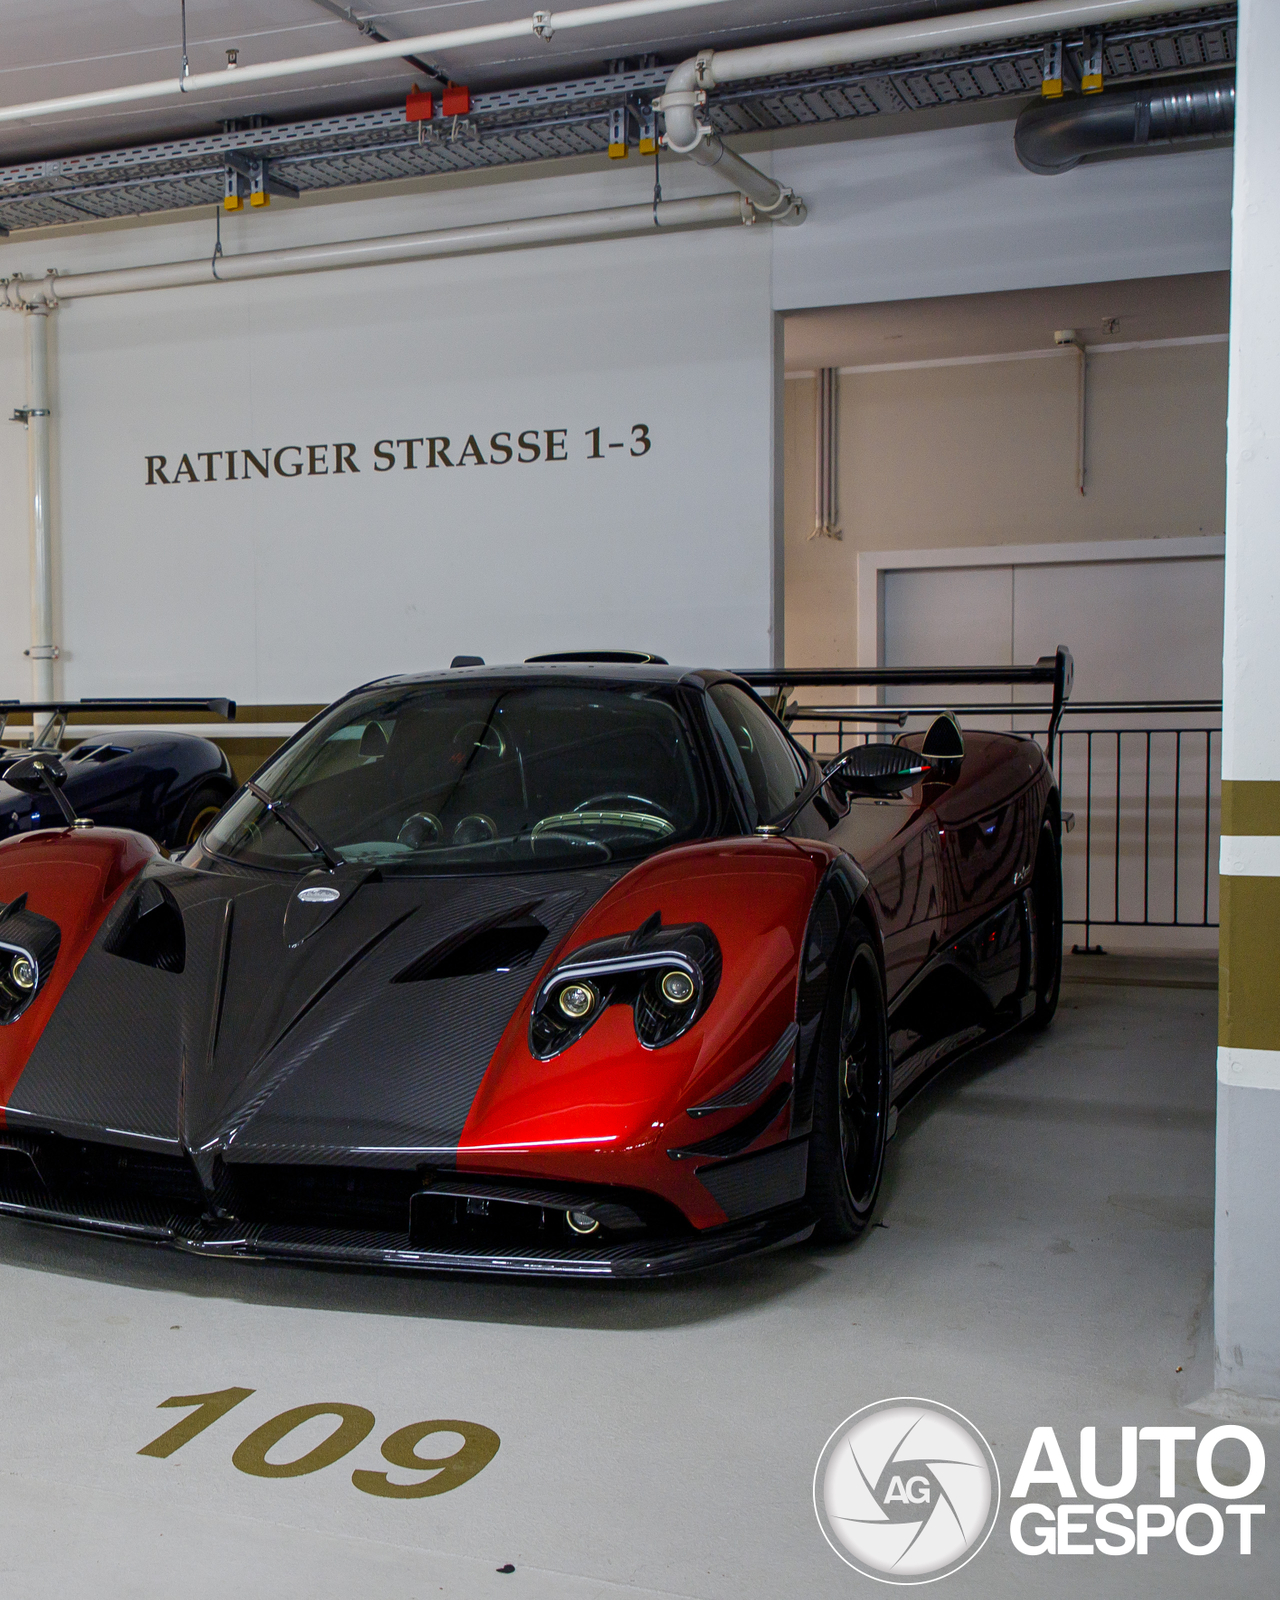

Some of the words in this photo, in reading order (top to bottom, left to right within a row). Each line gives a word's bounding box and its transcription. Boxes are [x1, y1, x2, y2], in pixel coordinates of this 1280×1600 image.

[144, 443, 361, 486] RATINGER
[373, 430, 568, 472] STRASSE
[137, 1386, 501, 1500] 109
